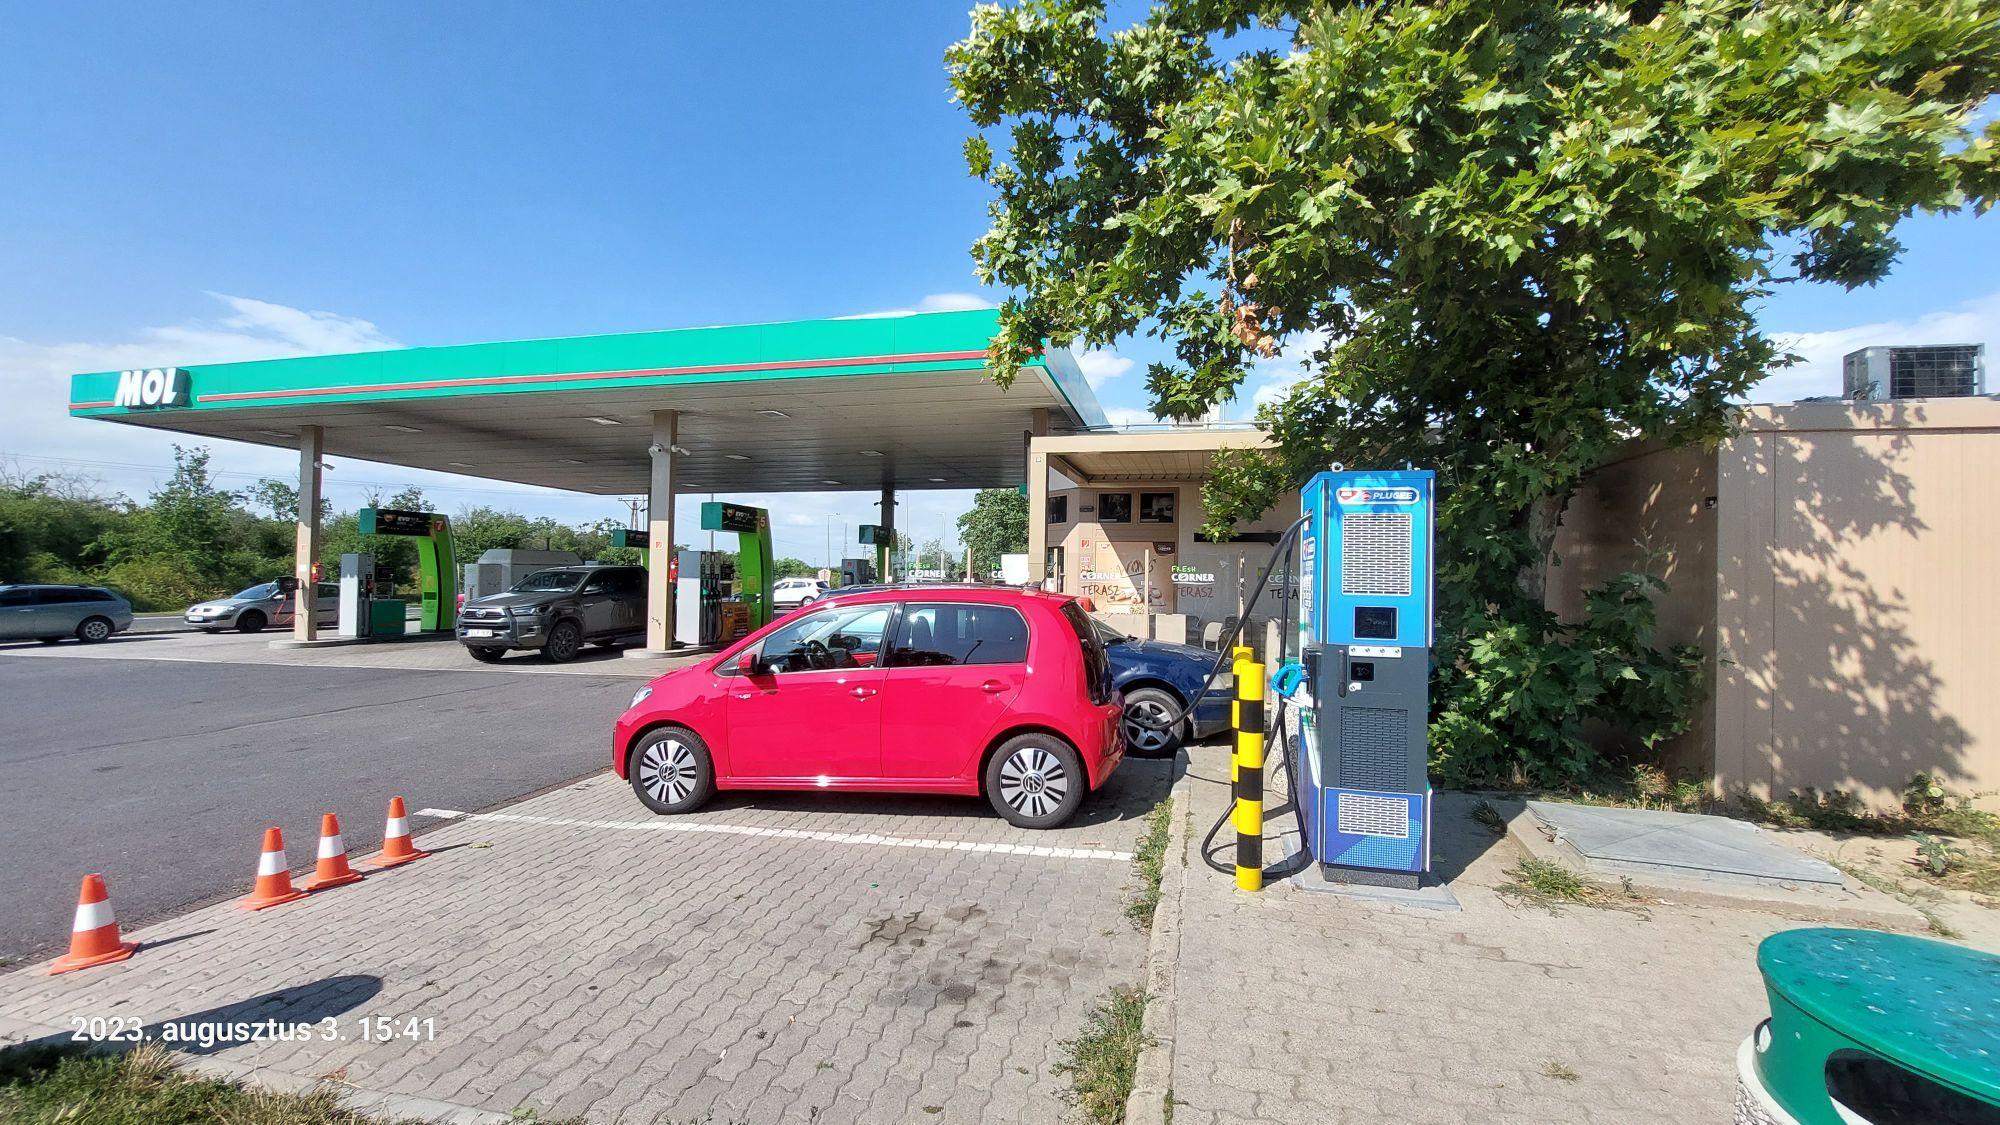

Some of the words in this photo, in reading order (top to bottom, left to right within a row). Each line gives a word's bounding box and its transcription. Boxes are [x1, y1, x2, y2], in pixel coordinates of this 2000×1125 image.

[114, 367, 178, 406] MOL
[1373, 492, 1413, 500] PLUGEE
[436, 520, 444, 532] 7
[760, 516, 766, 528] 5
[909, 569, 947, 578] CORNER
[1171, 573, 1215, 582] CORNER
[1081, 584, 1119, 596] TERASZ
